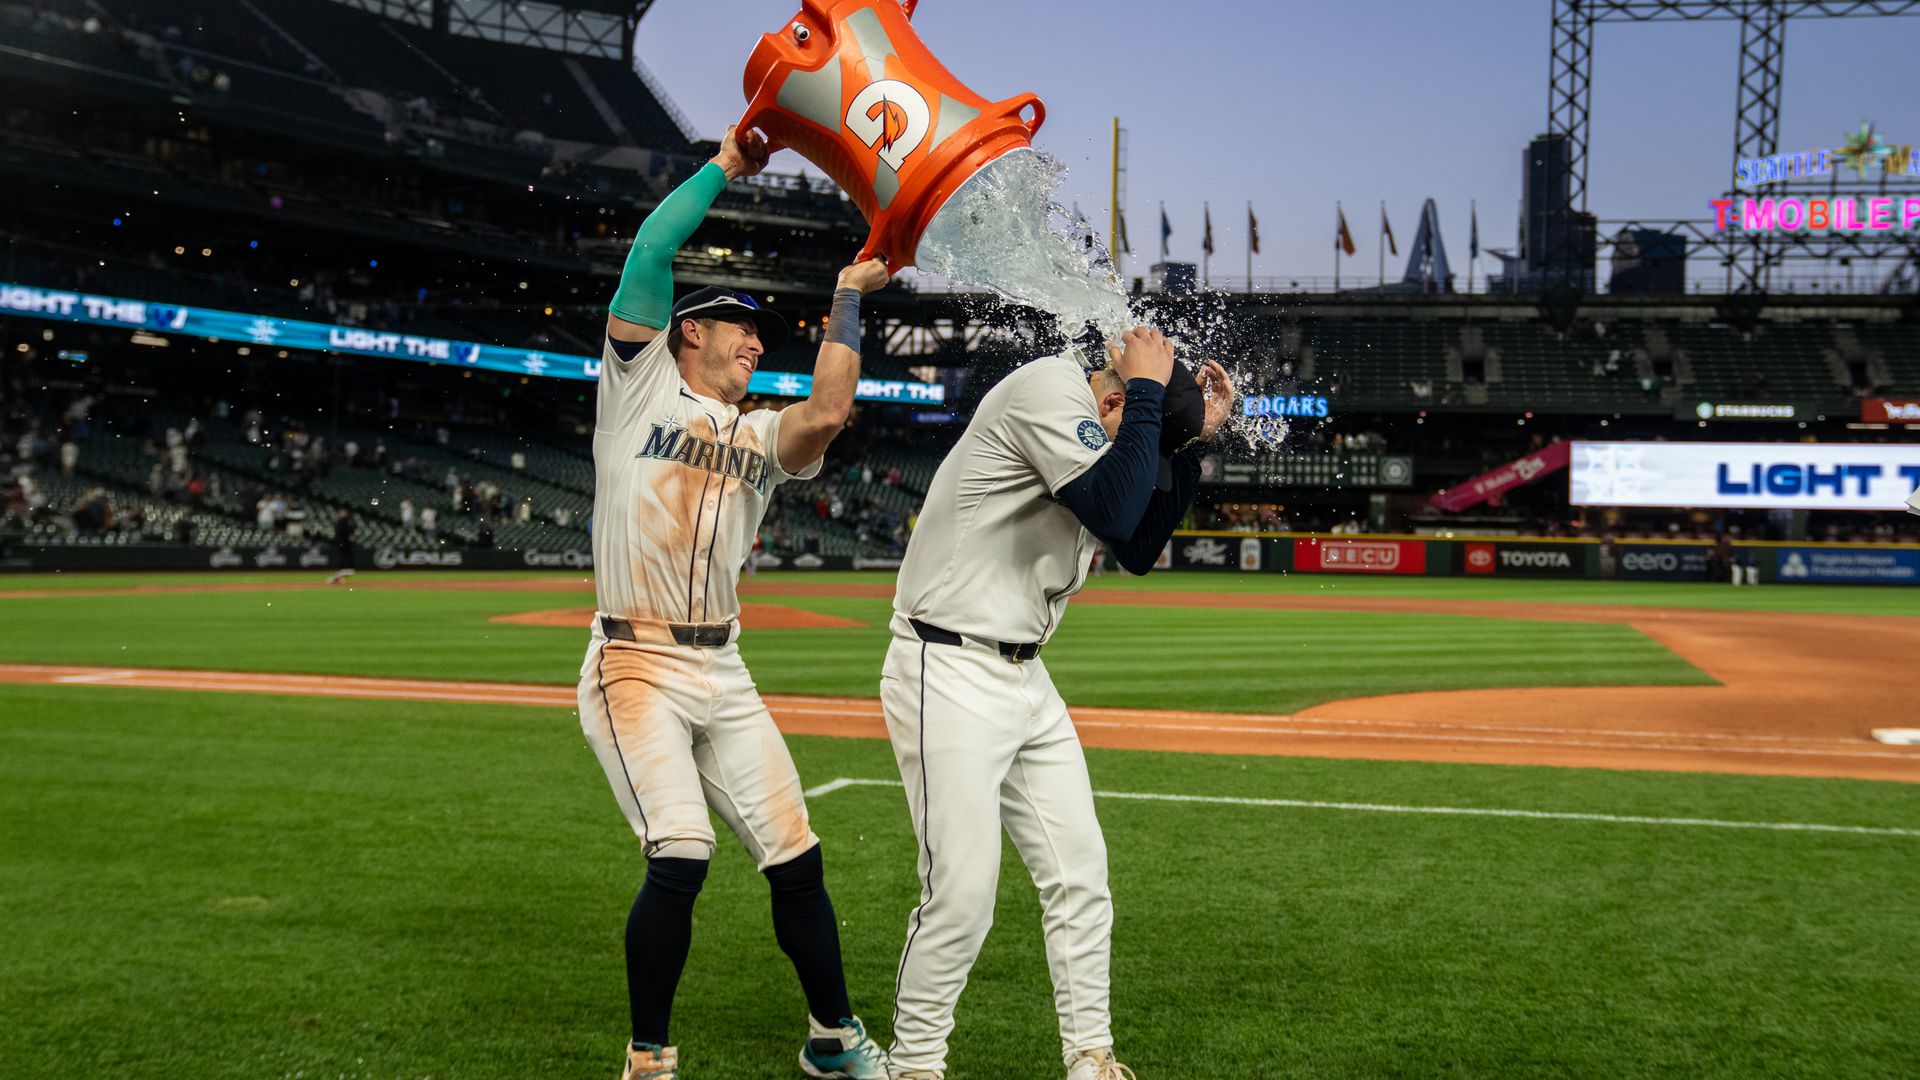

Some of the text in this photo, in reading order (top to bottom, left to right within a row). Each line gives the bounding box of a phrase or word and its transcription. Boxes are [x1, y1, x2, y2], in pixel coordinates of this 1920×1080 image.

[1736, 149, 1832, 188] SEATTLE
[1710, 198, 1893, 231] T-MOBILE
[0, 285, 79, 316] IGHT
[82, 295, 147, 324] THE
[329, 328, 401, 354] LIGHT
[403, 335, 450, 359] THE
[856, 380, 945, 402] IGHT THE
[1242, 396, 1329, 417] EDGARS
[1716, 463, 1883, 497] LIGHT
[1327, 548, 1394, 563] BECU
[1501, 551, 1571, 567] TOYOTA
[1622, 552, 1678, 571] eero
